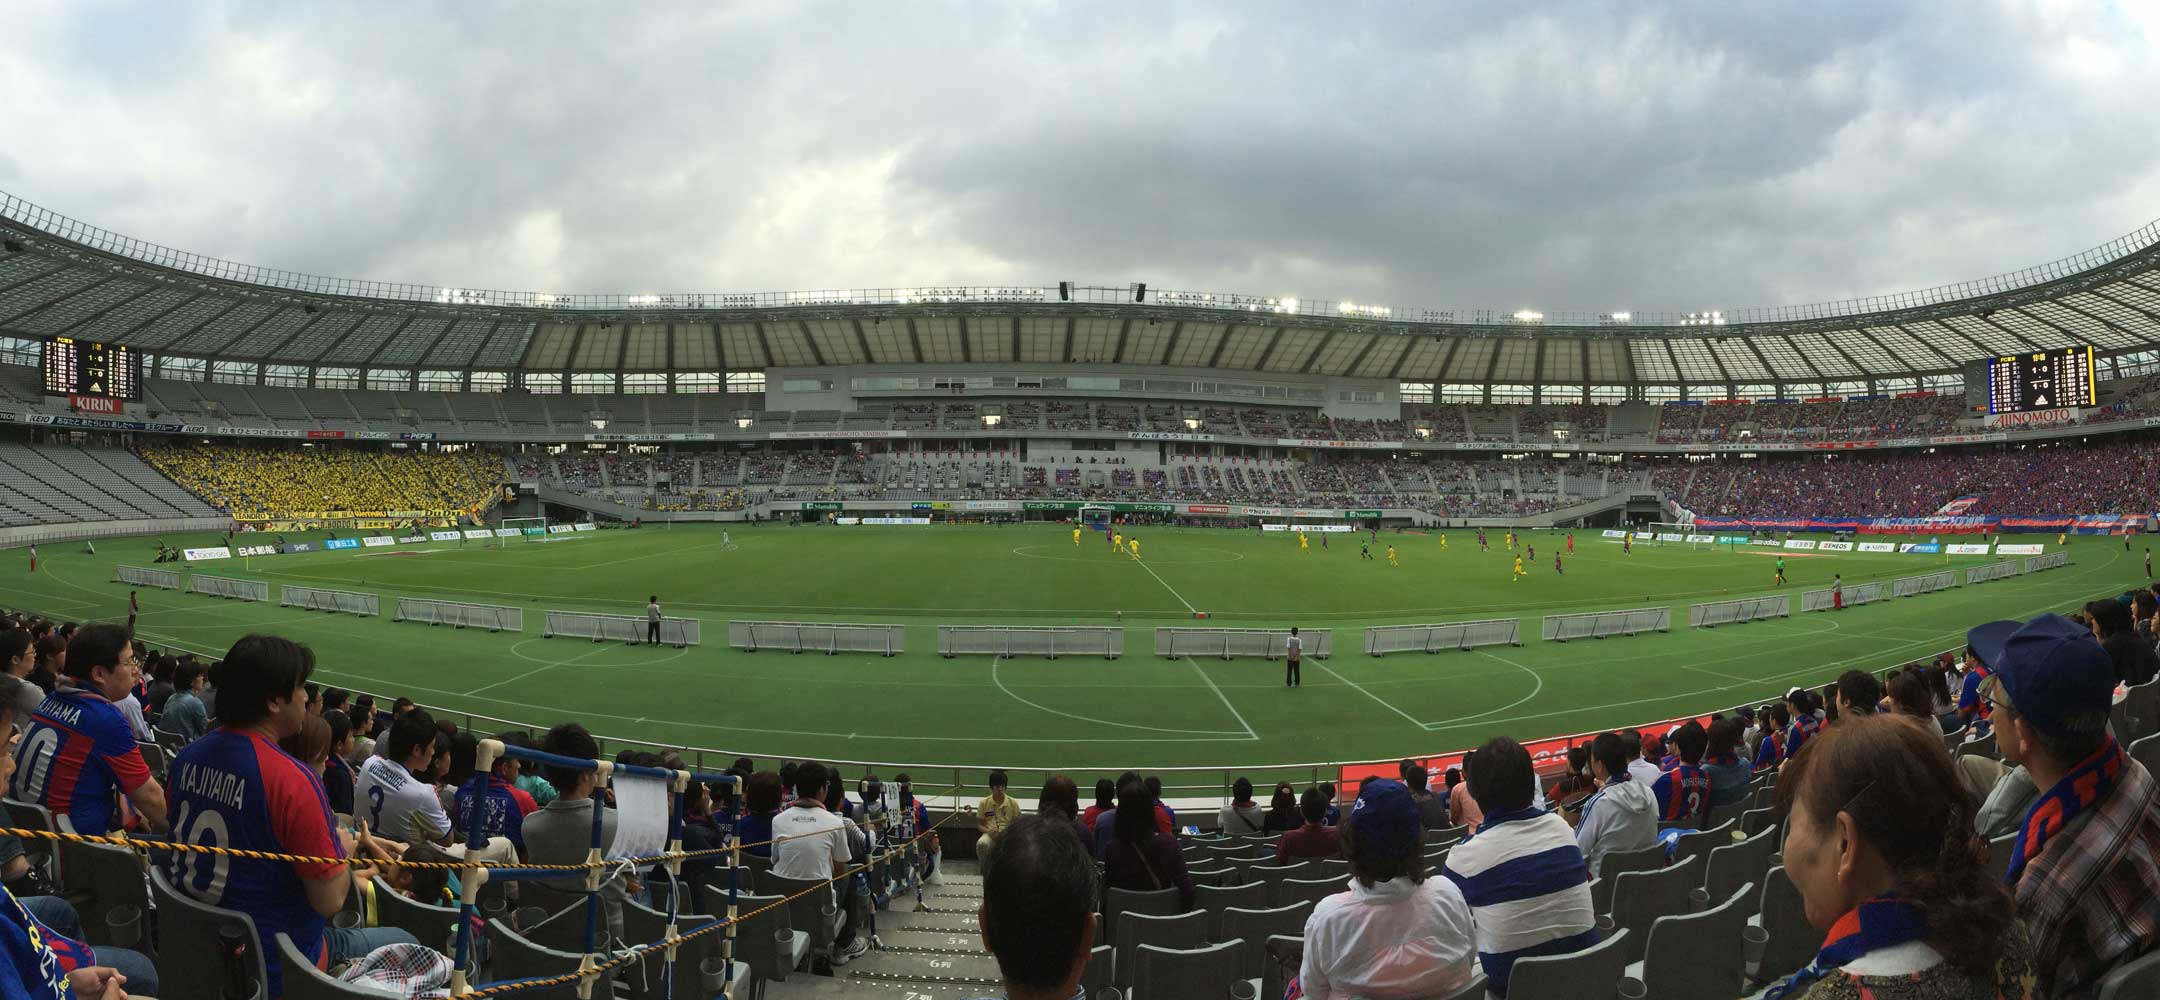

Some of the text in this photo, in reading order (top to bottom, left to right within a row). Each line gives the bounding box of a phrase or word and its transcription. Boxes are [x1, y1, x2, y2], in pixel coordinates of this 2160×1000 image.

[77, 397, 113, 412] KIRIN
[29, 415, 50, 424] KEIO
[1992, 409, 2070, 429] AJINOMOTO
[238, 545, 277, 557] 日本郵船
[180, 762, 246, 811] KAJIYAMA
[170, 799, 230, 903] 10
